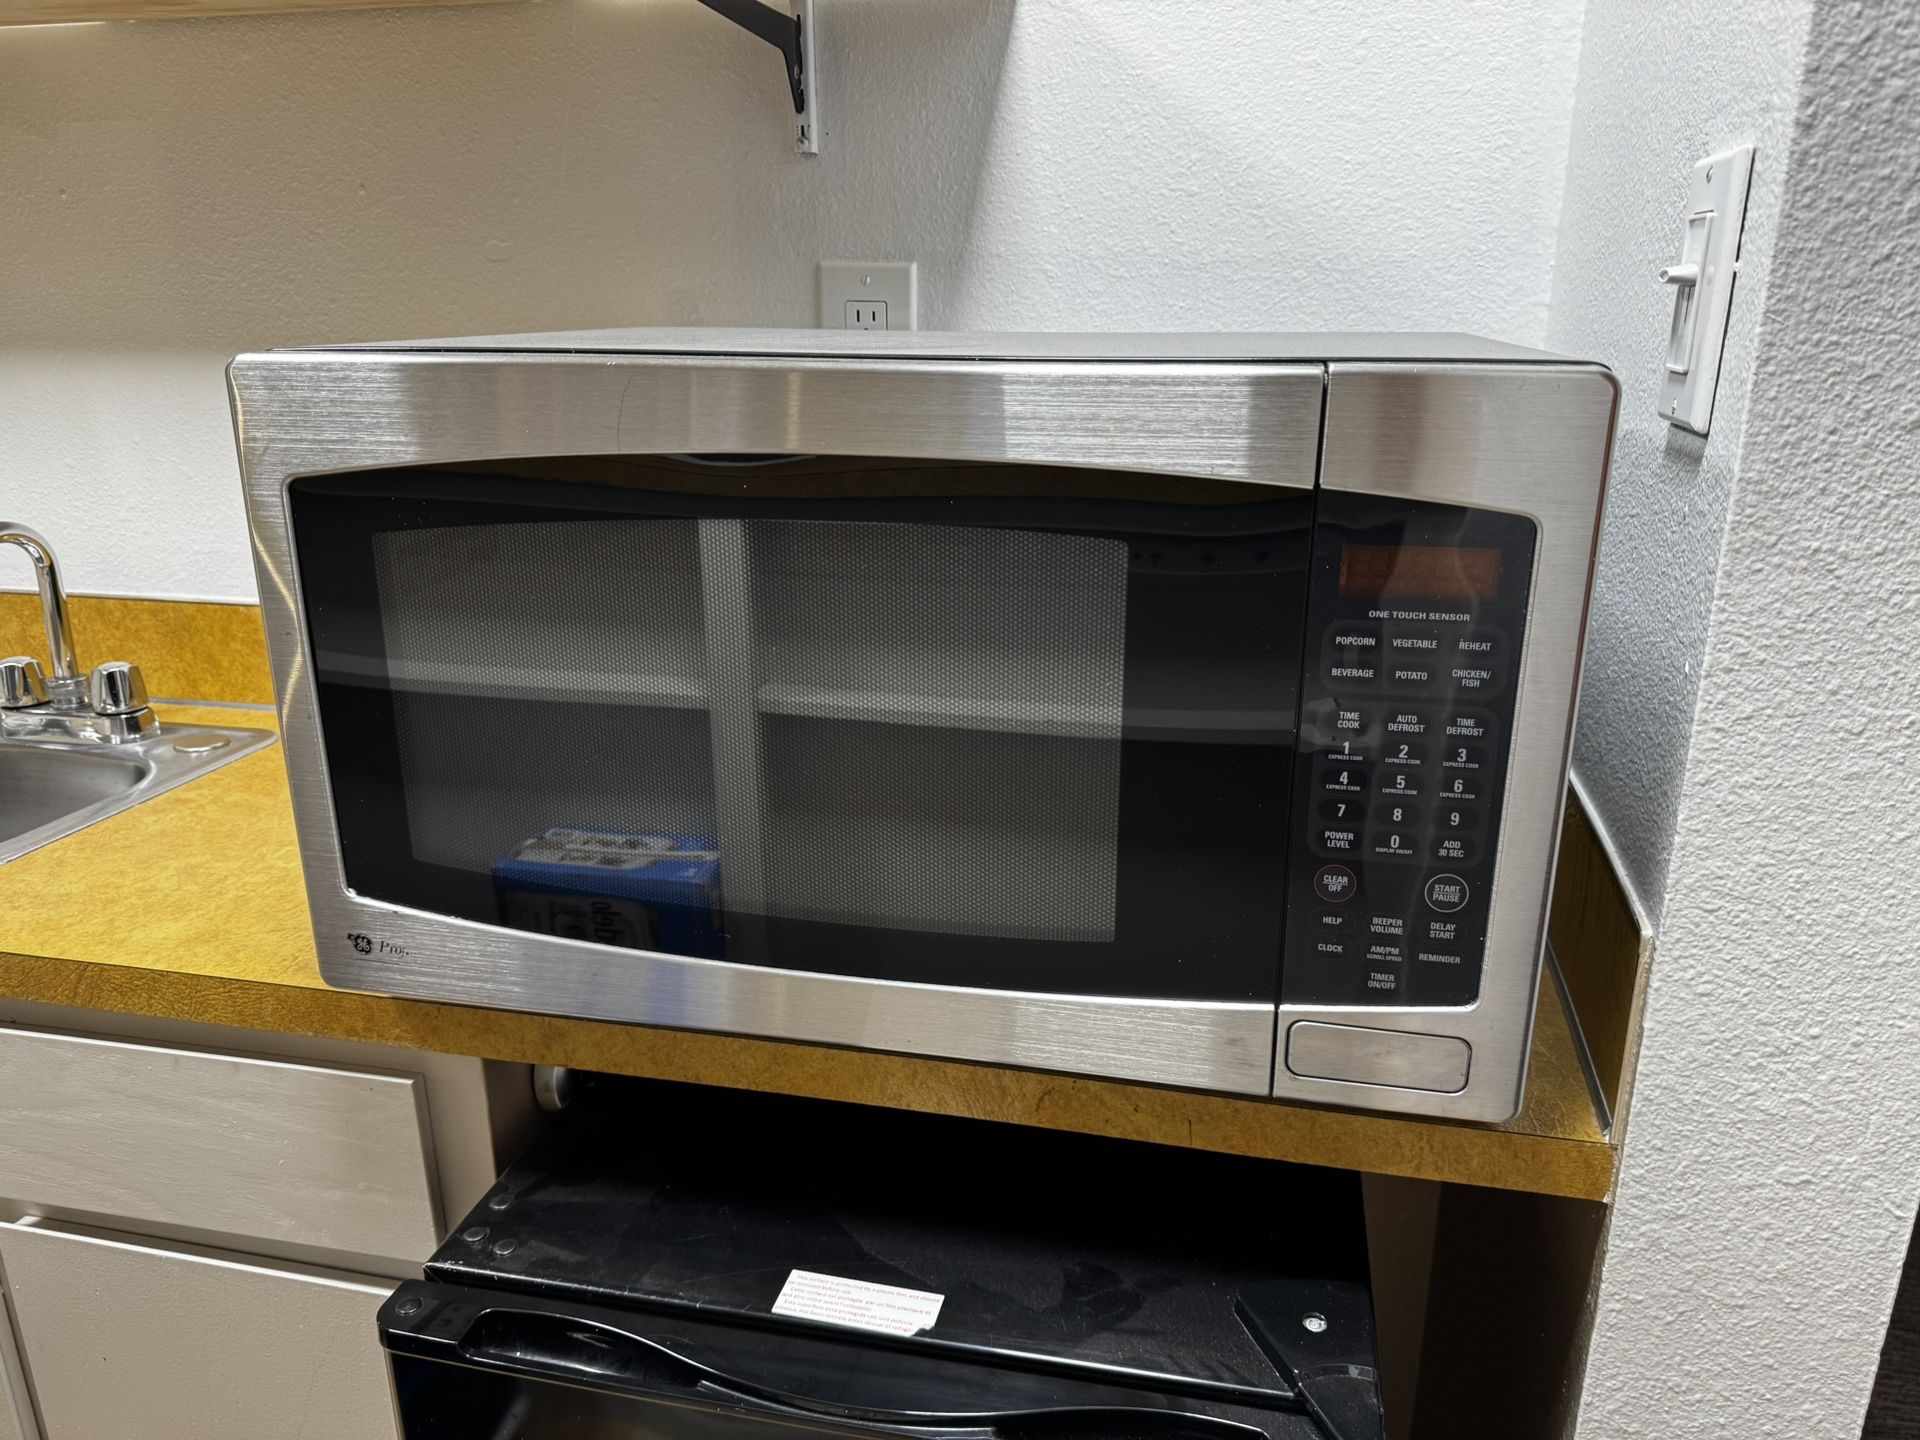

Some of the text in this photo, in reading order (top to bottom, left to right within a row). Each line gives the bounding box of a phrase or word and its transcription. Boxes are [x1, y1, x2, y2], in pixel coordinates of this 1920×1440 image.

[1369, 611, 1470, 621] ONE TOUCH SENSOR
[1336, 637, 1375, 646] POPCORN
[1393, 639, 1437, 648] VEGETABLE
[1459, 641, 1492, 651] REHEAT
[1332, 668, 1374, 678] BEVERAGE
[1396, 671, 1427, 680] POTATO
[1452, 669, 1491, 679] CHICKEN/
[1462, 679, 1480, 687] FISH
[1339, 712, 1360, 720] TIME
[1397, 715, 1417, 723] AUTO
[1338, 720, 1360, 729] COOK
[1457, 718, 1475, 727] TIME
[1388, 723, 1425, 733] DEFROST
[1447, 726, 1484, 736] DEFROST
[1343, 741, 1350, 755] 1
[1399, 745, 1408, 758] 2
[1457, 749, 1467, 762] 3
[1340, 771, 1348, 784] 4
[1396, 775, 1405, 789] 5
[1454, 779, 1463, 792] 6
[1337, 804, 1346, 817] 7
[1393, 808, 1402, 822] 8
[1450, 812, 1460, 825] 9
[1325, 831, 1353, 840] POWER
[1327, 840, 1350, 848] LEVEL
[1390, 835, 1399, 848] 0
[1443, 840, 1461, 848] ADD
[1449, 849, 1464, 858] SEC
[1323, 875, 1348, 883] CLEAR
[1328, 884, 1342, 892] OFF
[1435, 884, 1460, 893] START
[1433, 894, 1460, 903] PAUSE
[1323, 916, 1342, 925] HELP
[1373, 917, 1402, 926] BEEPER
[1371, 925, 1403, 935] VOLUME
[1431, 922, 1456, 931] DELAY
[1430, 930, 1455, 940] START
[1318, 944, 1343, 952] CLOCK
[1370, 945, 1399, 955] AM/PM
[1419, 953, 1460, 964] REMINDER
[1370, 973, 1394, 982] TIMER
[1368, 980, 1396, 990] ON/OFF
